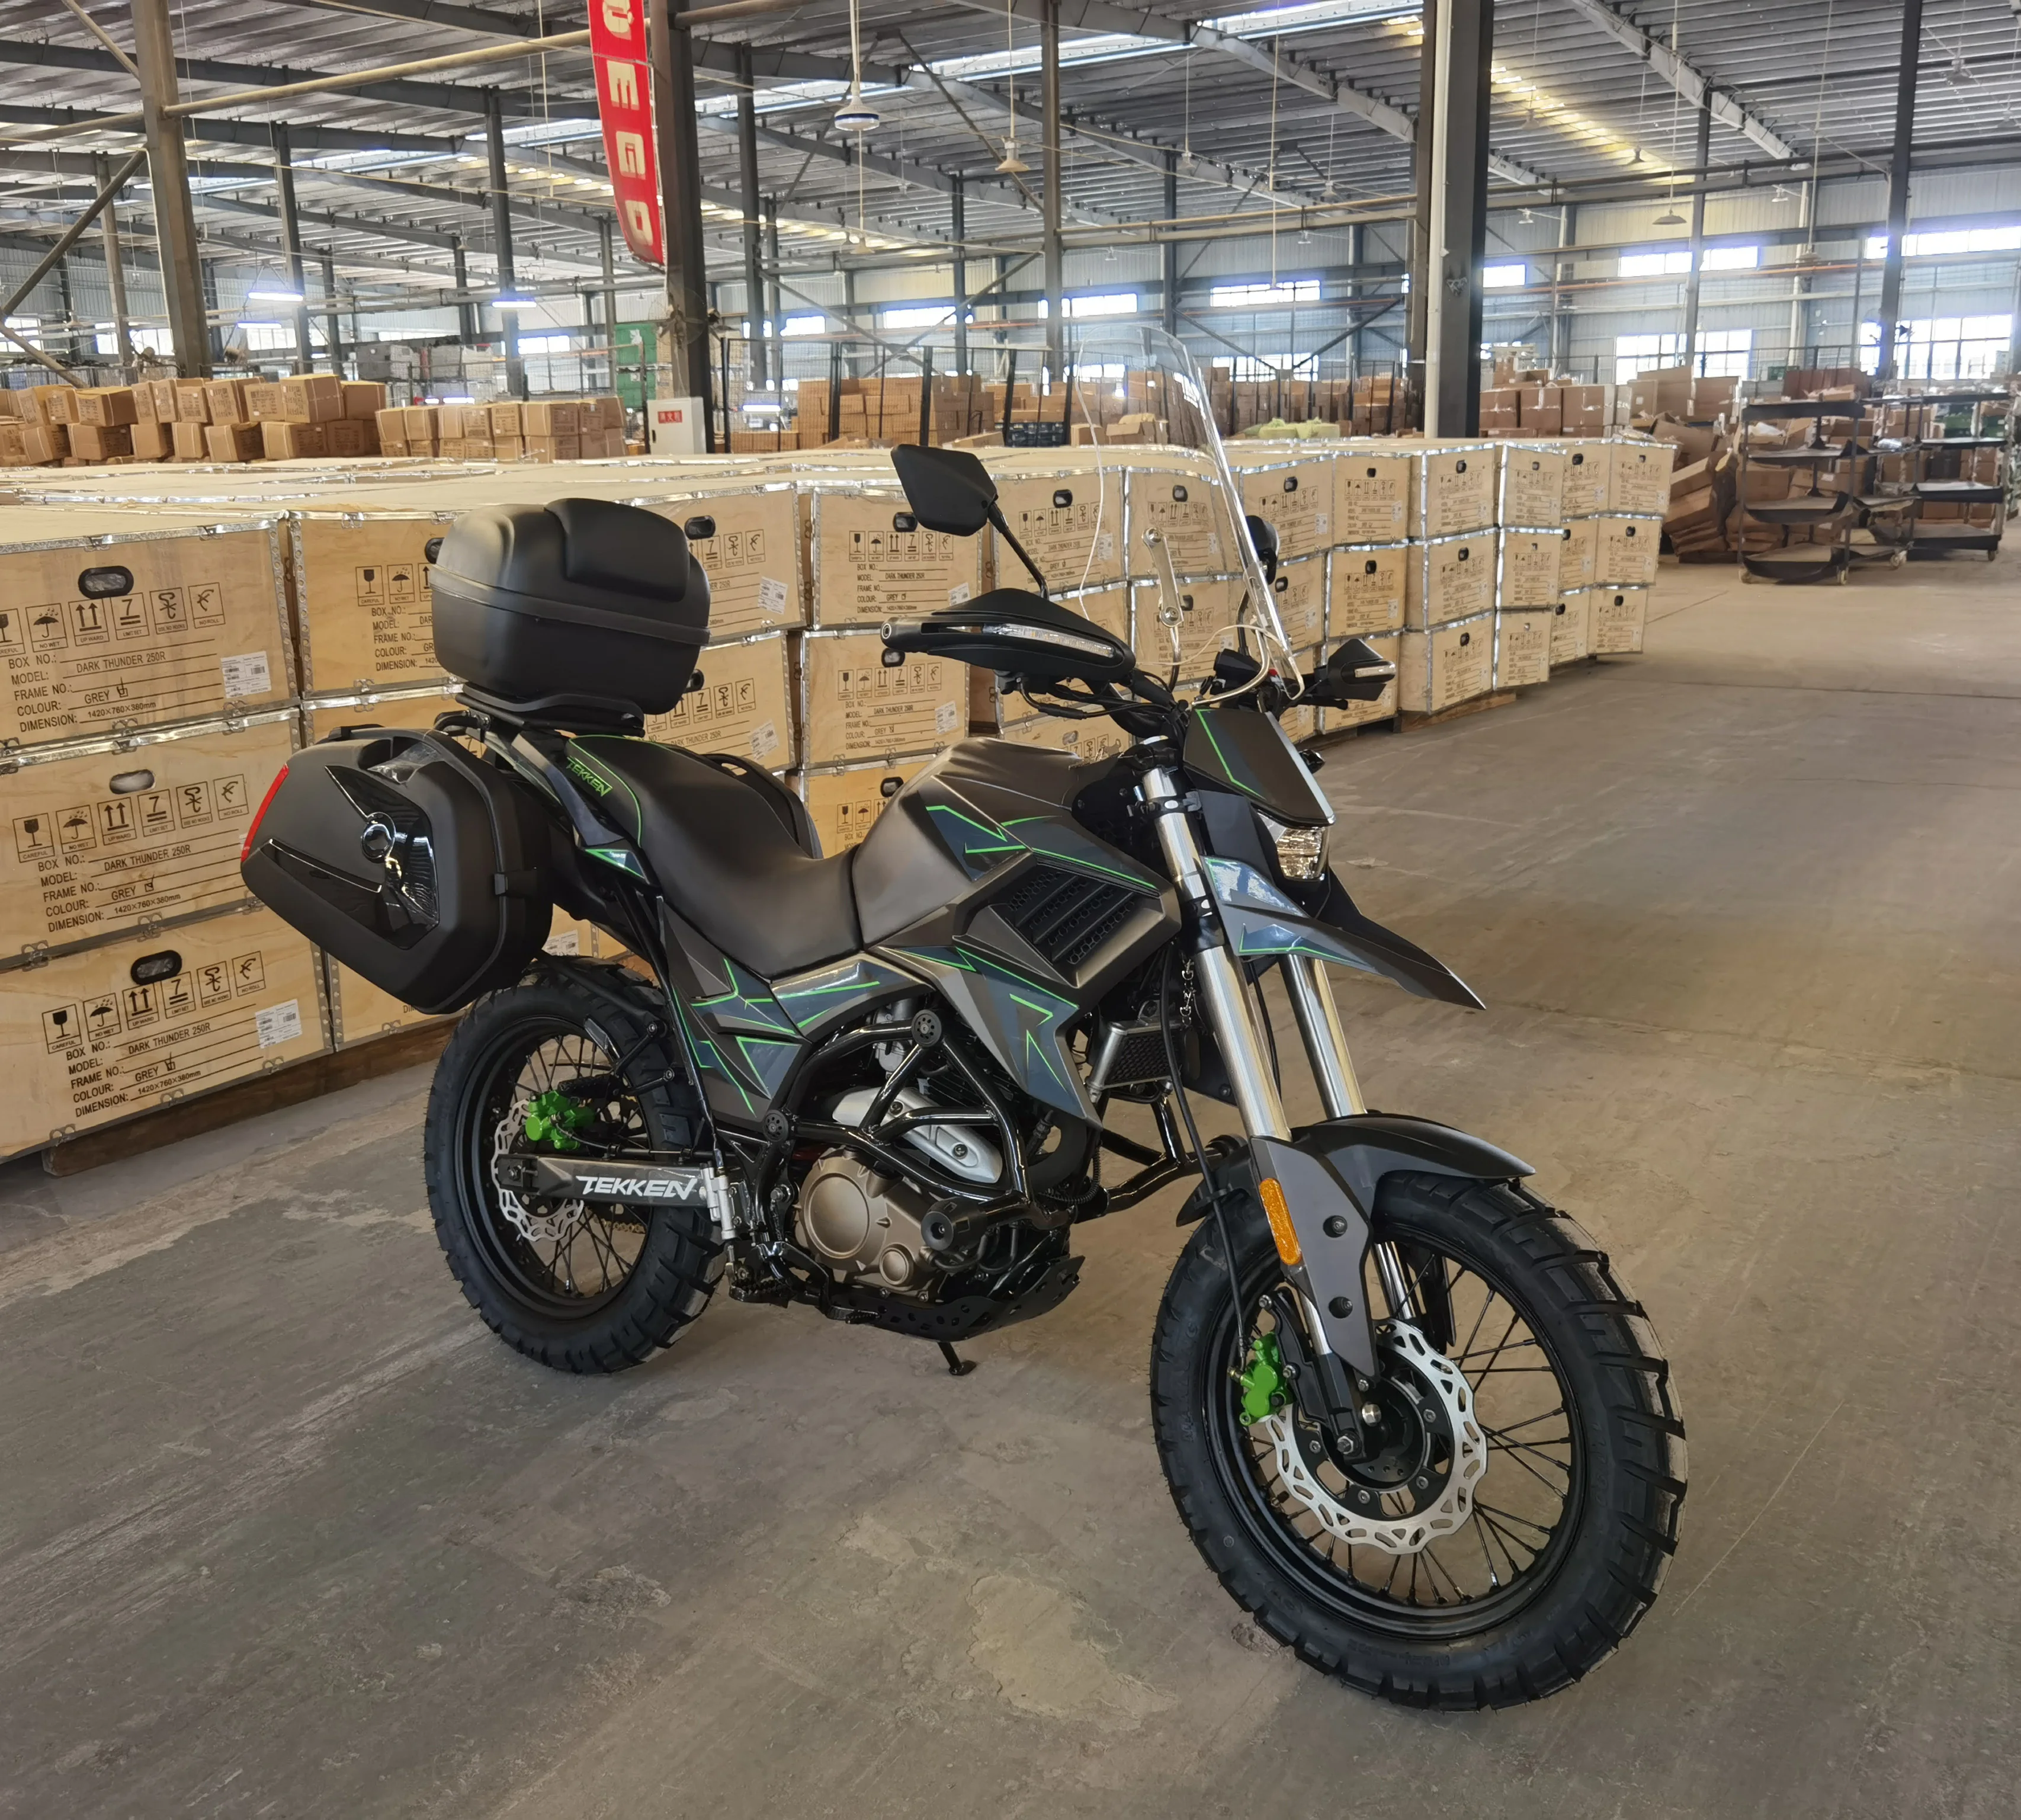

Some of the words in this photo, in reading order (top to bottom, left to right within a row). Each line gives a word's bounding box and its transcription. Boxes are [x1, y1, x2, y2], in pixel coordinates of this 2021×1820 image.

[371, 607, 386, 616] BOX
[373, 620, 400, 630] MODEL:
[419, 616, 432, 624] DAR
[373, 633, 398, 644] FRAME
[375, 646, 407, 658] COLOUR:
[424, 642, 434, 652] GR
[8, 656, 30, 669] BOX
[36, 654, 57, 664] NO.:
[11, 672, 49, 685] MODEL:
[76, 661, 101, 673] DARK
[103, 655, 143, 668] THUNDER
[146, 652, 166, 662] 250R
[376, 658, 417, 672] DIMENSION:
[14, 686, 49, 700] FRAME
[84, 690, 110, 704] GREY
[17, 700, 62, 716] COLOUR:
[20, 713, 78, 732] DIMENSION:
[566, 757, 612, 796] TEKKEN
[23, 850, 49, 859] CAREFUL
[38, 859, 59, 872] BOX
[40, 873, 78, 887] MODEL:
[104, 859, 127, 871] DARK
[131, 849, 170, 865] THUNDER
[172, 845, 191, 855] 250R
[43, 886, 76, 902] FRAME
[111, 886, 136, 901] GREY
[46, 899, 89, 917] COLOUR:
[48, 911, 104, 933] DIMENSION:
[52, 1040, 76, 1050] CAREFUL
[68, 1058, 104, 1075] MODEL:
[128, 1043, 150, 1055] DARK
[153, 1030, 190, 1048] THUNDER
[193, 1023, 211, 1034] 250R
[66, 1047, 86, 1060] BOX
[70, 1073, 103, 1089] FRAME
[135, 1066, 159, 1082] GREY
[73, 1083, 114, 1103] COLOUR:
[75, 1094, 129, 1117] DIMENSION:
[576, 1175, 698, 1200] TEKKEN
